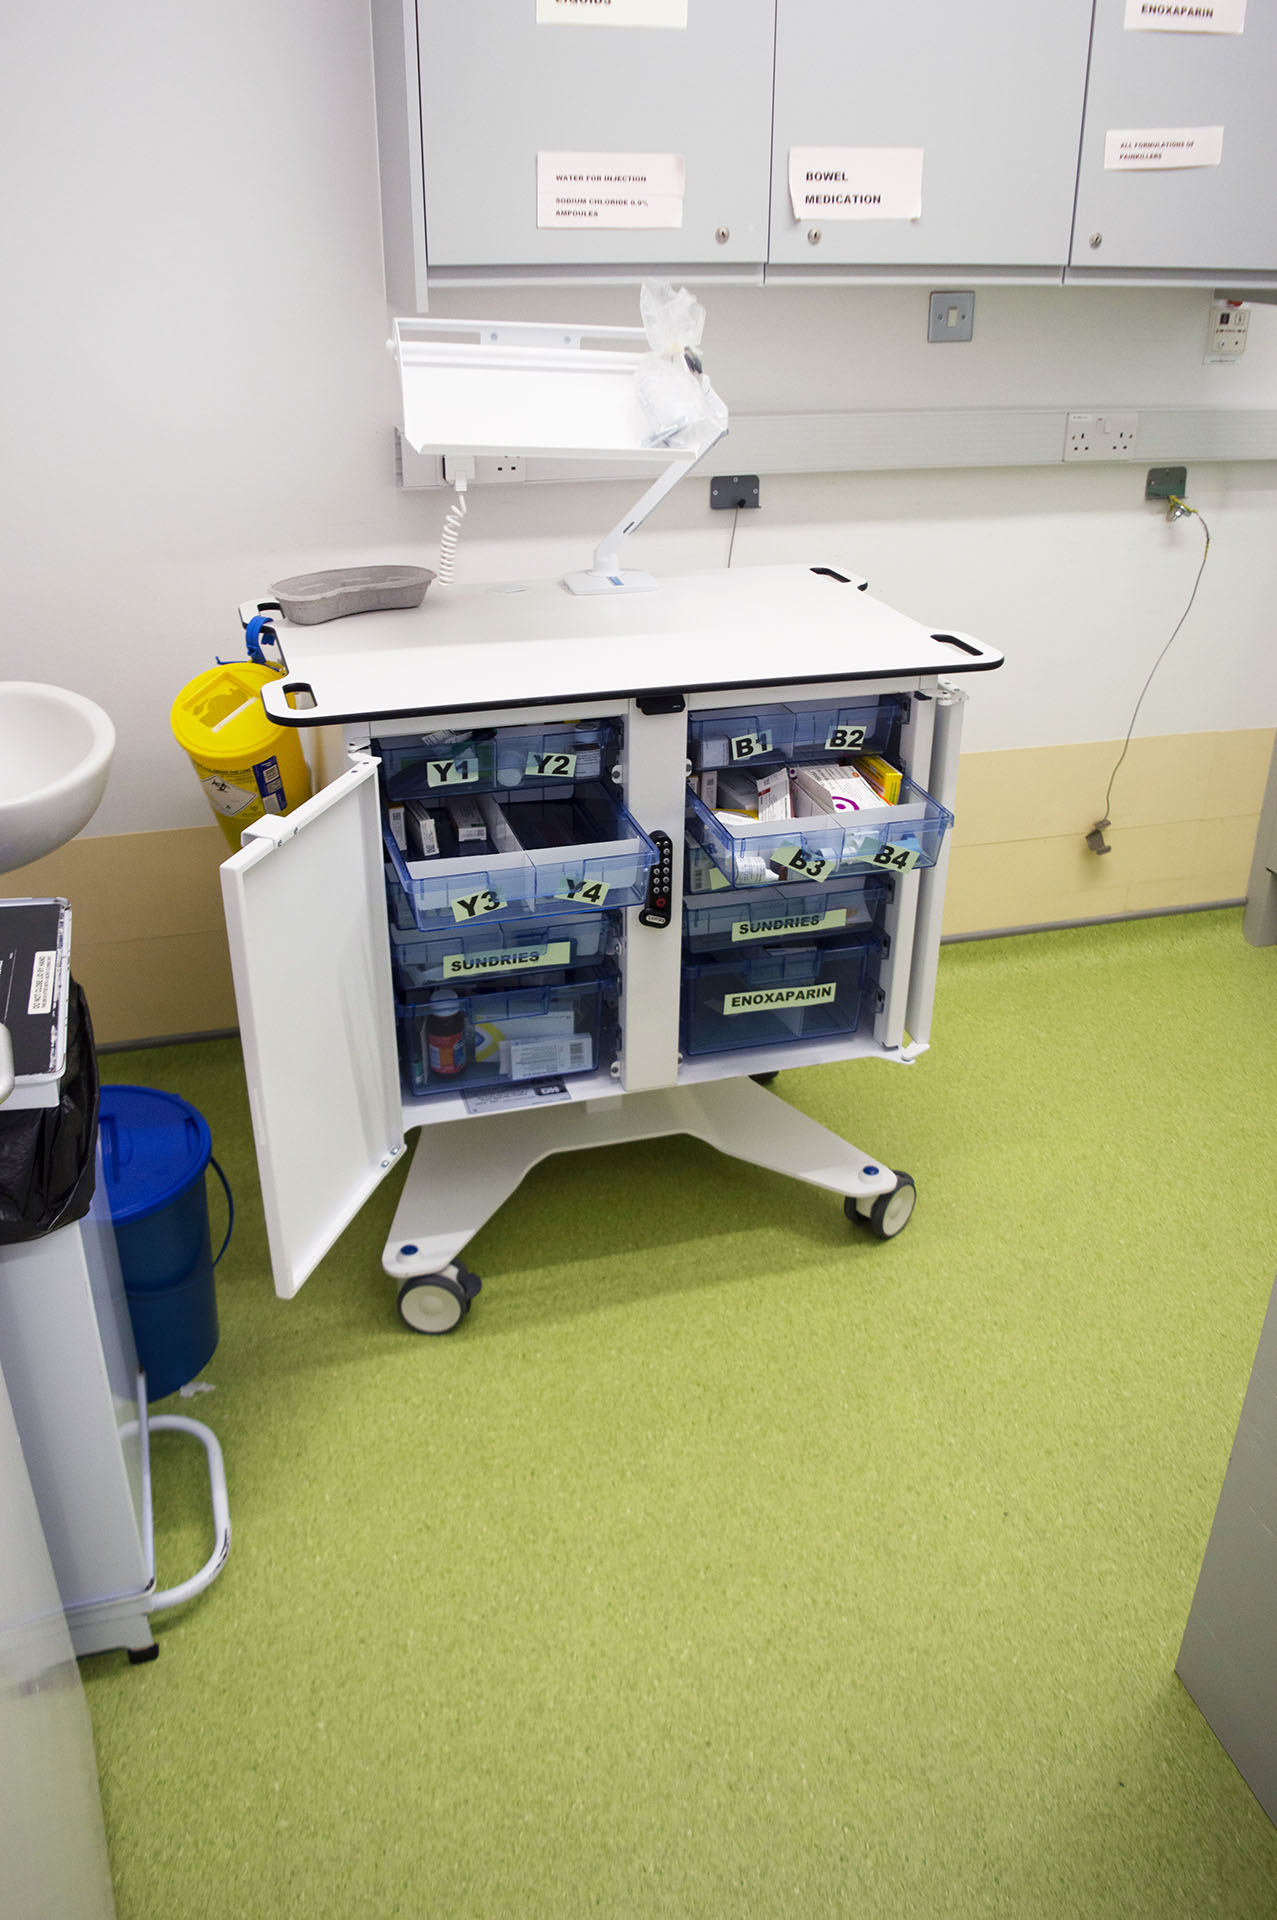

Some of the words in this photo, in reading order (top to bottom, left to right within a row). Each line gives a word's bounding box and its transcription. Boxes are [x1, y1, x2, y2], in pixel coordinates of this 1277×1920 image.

[1141, 3, 1215, 18] ENOXAPARIN
[555, 174, 584, 182] WATER
[604, 175, 647, 183] INJECTION
[805, 171, 848, 182] BOWEL
[555, 197, 588, 205] SODIUM
[804, 194, 882, 204] MEDICATION
[555, 209, 599, 217] AMPOULES
[736, 732, 769, 757] B1
[829, 728, 865, 748] B2
[432, 759, 469, 782] Y1
[533, 754, 571, 776] Y2
[789, 848, 826, 877] B3
[873, 844, 911, 869] B4
[566, 878, 602, 903] Y4
[456, 891, 500, 918] Y3
[738, 914, 821, 935] SUNDRIES
[450, 951, 541, 973] SUNDRIES
[730, 986, 832, 1007] ENOXAPARIN
